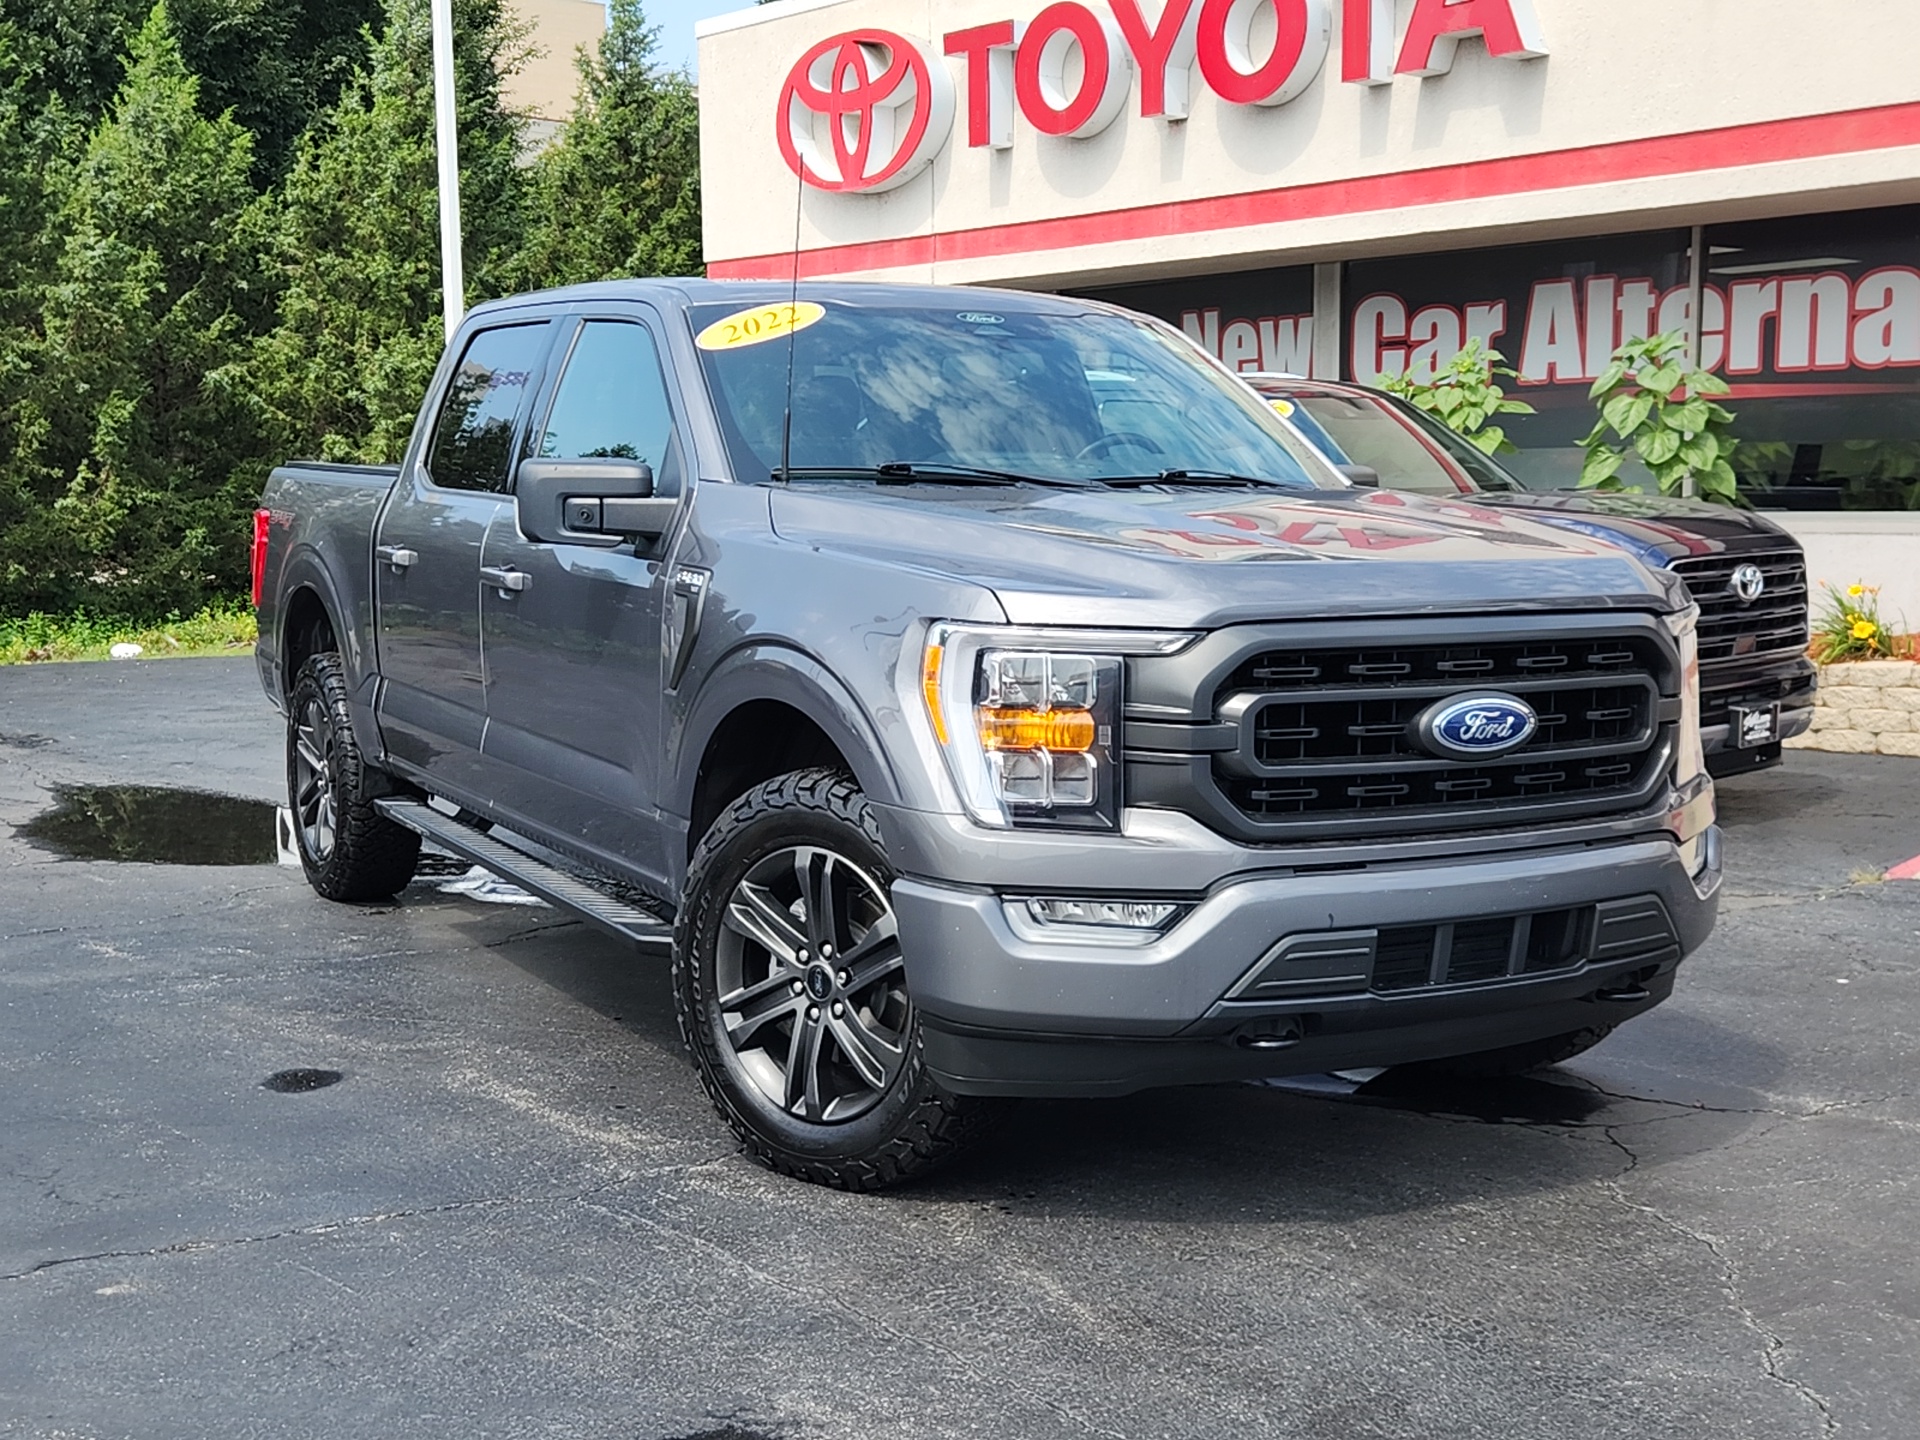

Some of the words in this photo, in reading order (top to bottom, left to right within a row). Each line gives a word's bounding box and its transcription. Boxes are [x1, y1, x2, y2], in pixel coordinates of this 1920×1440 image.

[722, 306, 800, 343] 2022
[1181, 307, 1314, 380] New
[1351, 292, 1505, 390] Car
[1459, 710, 1515, 740] Ford
